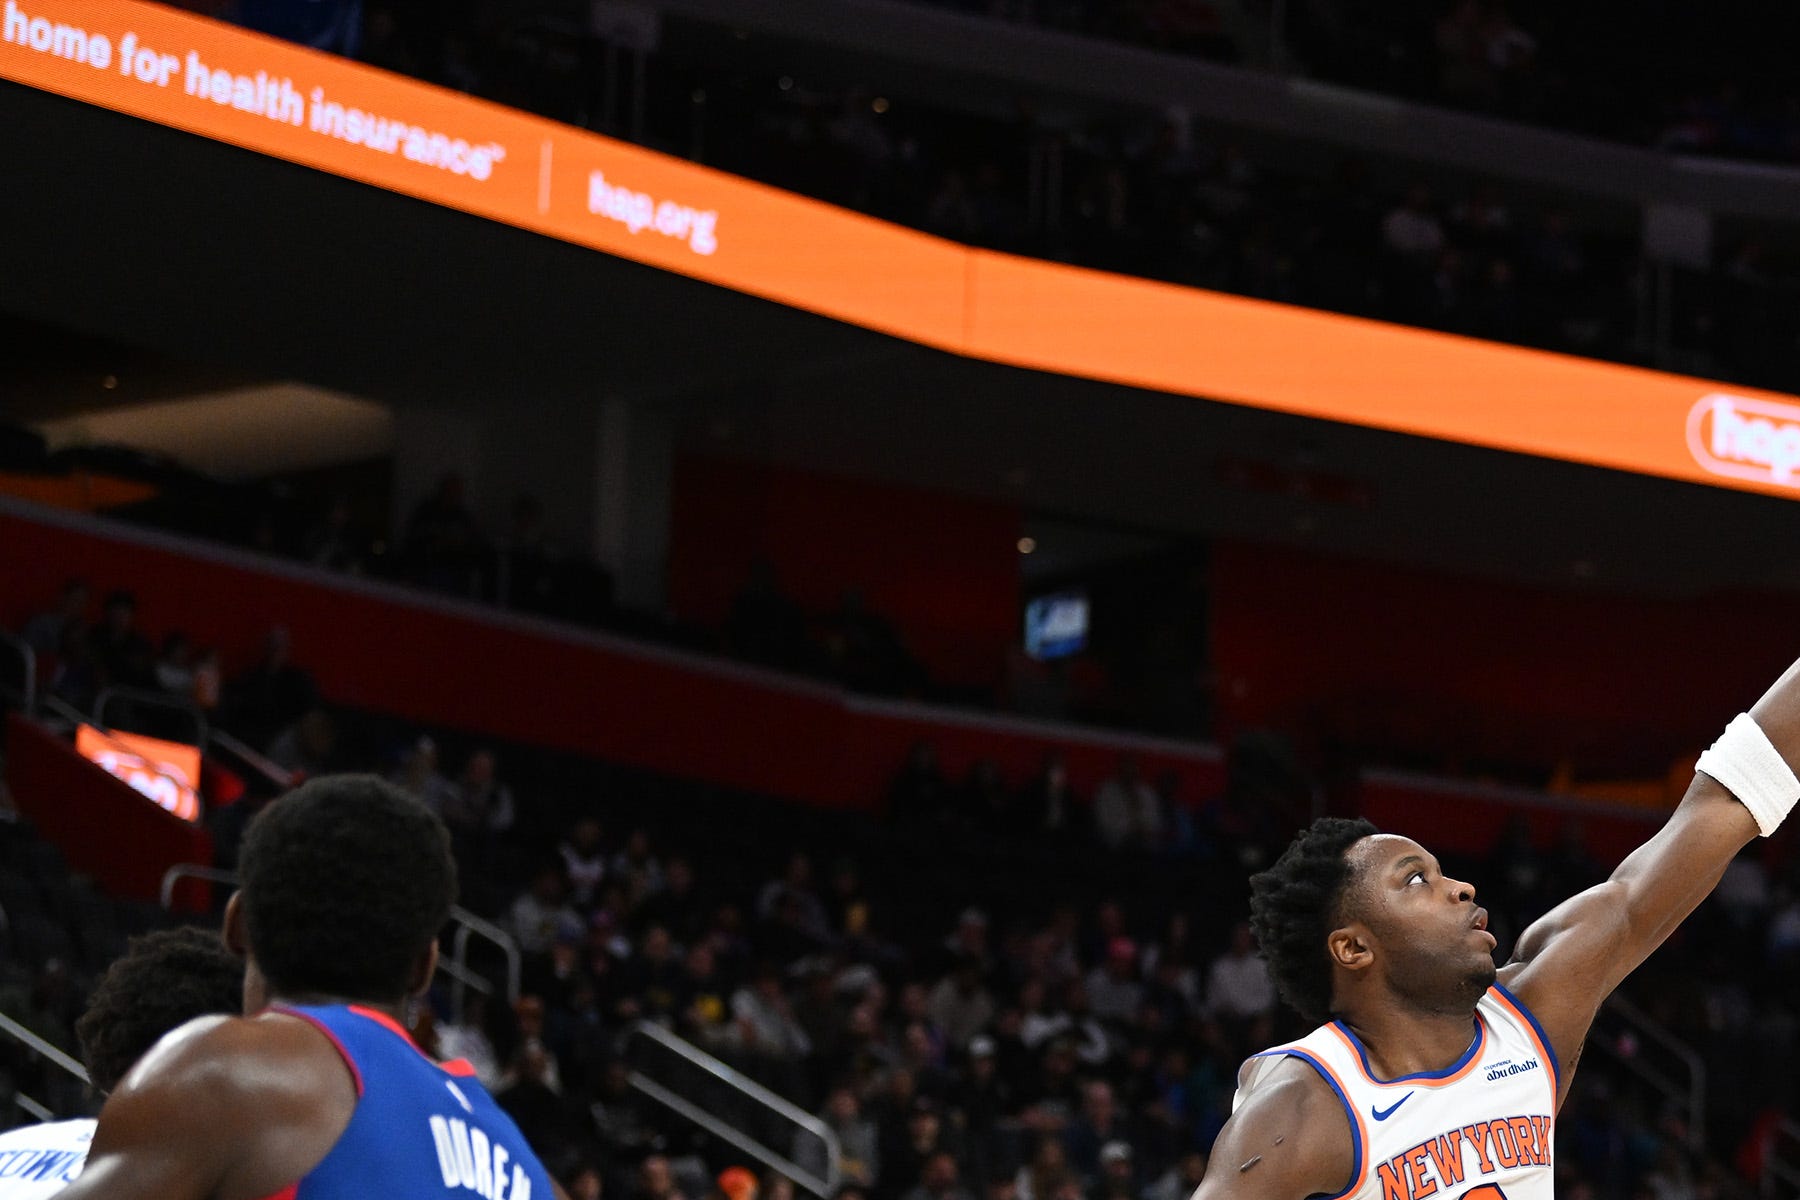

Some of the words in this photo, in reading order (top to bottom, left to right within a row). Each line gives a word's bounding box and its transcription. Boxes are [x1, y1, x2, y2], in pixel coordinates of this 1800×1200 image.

[3, 0, 112, 69] home
[119, 31, 181, 87] for
[184, 49, 305, 126] health
[588, 171, 718, 255] hap.org
[1486, 1069, 1508, 1082] abu
[1508, 1057, 1539, 1076] dhabi
[1462, 1114, 1552, 1175] YORK
